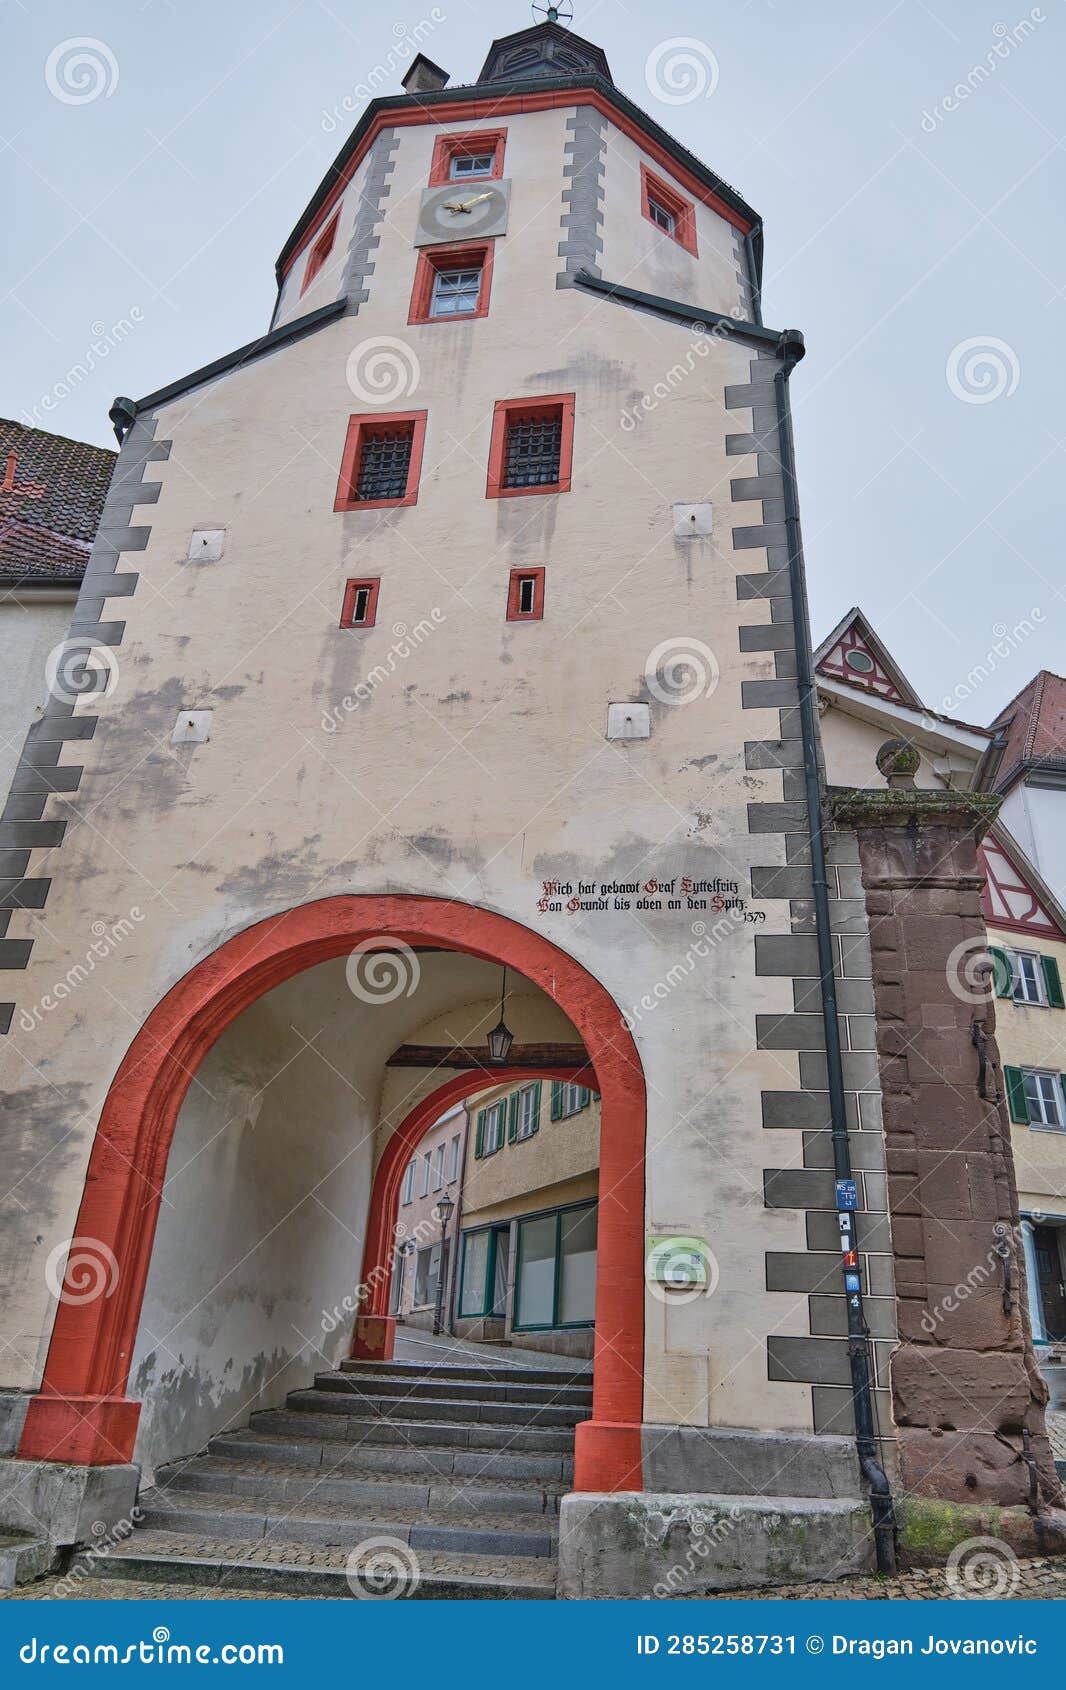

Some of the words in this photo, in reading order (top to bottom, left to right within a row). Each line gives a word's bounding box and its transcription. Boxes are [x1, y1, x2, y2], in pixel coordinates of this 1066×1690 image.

[542, 878, 573, 897] Mich
[578, 880, 596, 894] hat
[600, 880, 640, 896] gebawt
[642, 877, 678, 897] Graf
[536, 897, 562, 916] Von
[565, 896, 609, 916] Grundt
[614, 895, 630, 911] bis
[636, 895, 662, 911] oben
[667, 899, 681, 911] an
[687, 896, 707, 911] den
[711, 893, 748, 914] Spitz.
[743, 911, 766, 924] 1579
